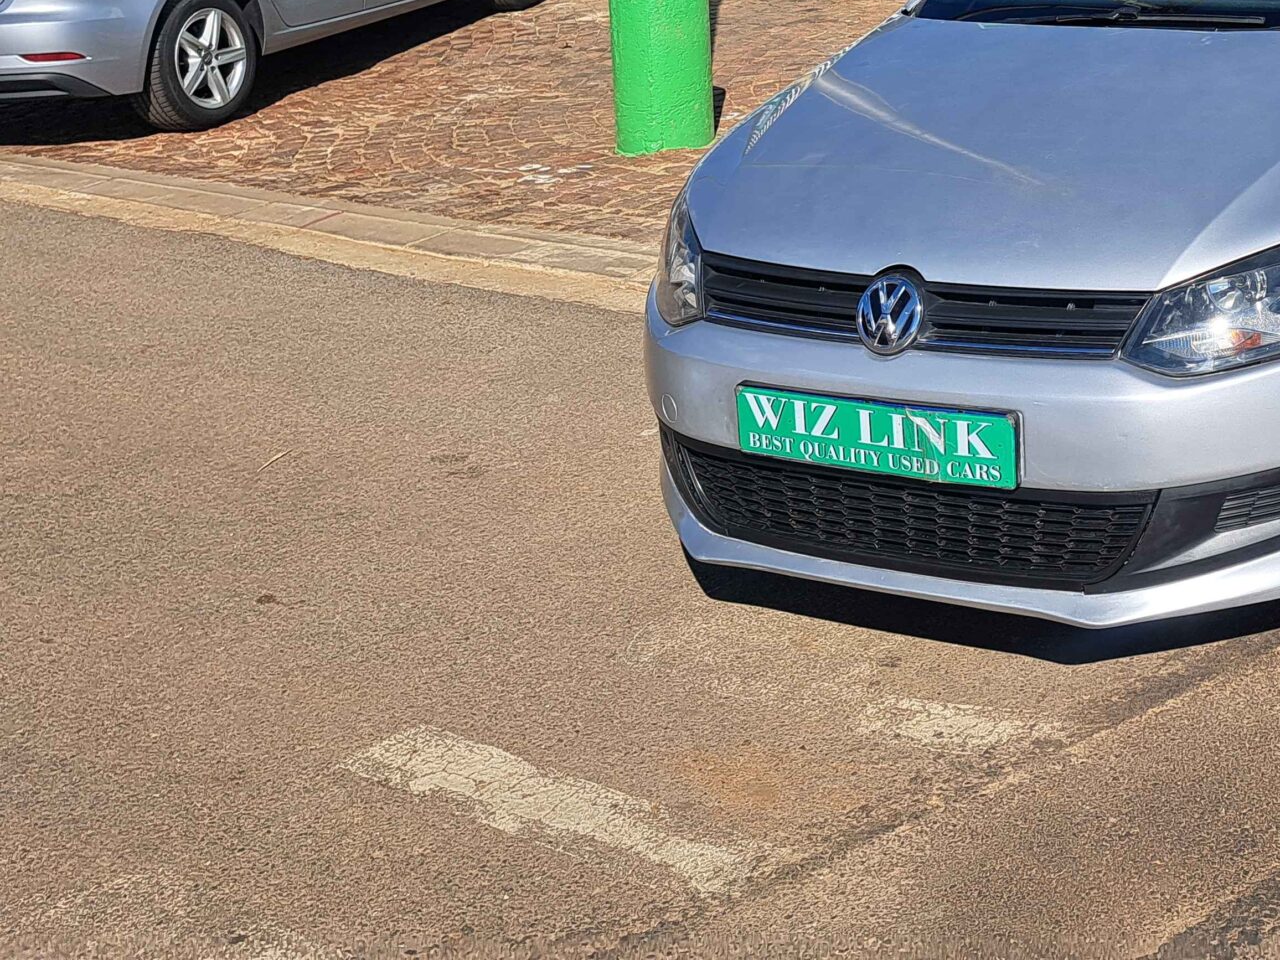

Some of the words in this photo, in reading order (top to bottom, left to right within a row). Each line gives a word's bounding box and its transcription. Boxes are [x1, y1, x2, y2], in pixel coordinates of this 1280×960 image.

[742, 392, 839, 440] WIZ
[856, 408, 998, 460] LINK
[749, 431, 794, 454] BEST
[799, 440, 882, 468] QUALITY
[888, 454, 940, 476] USED
[946, 460, 1002, 483] CARS
